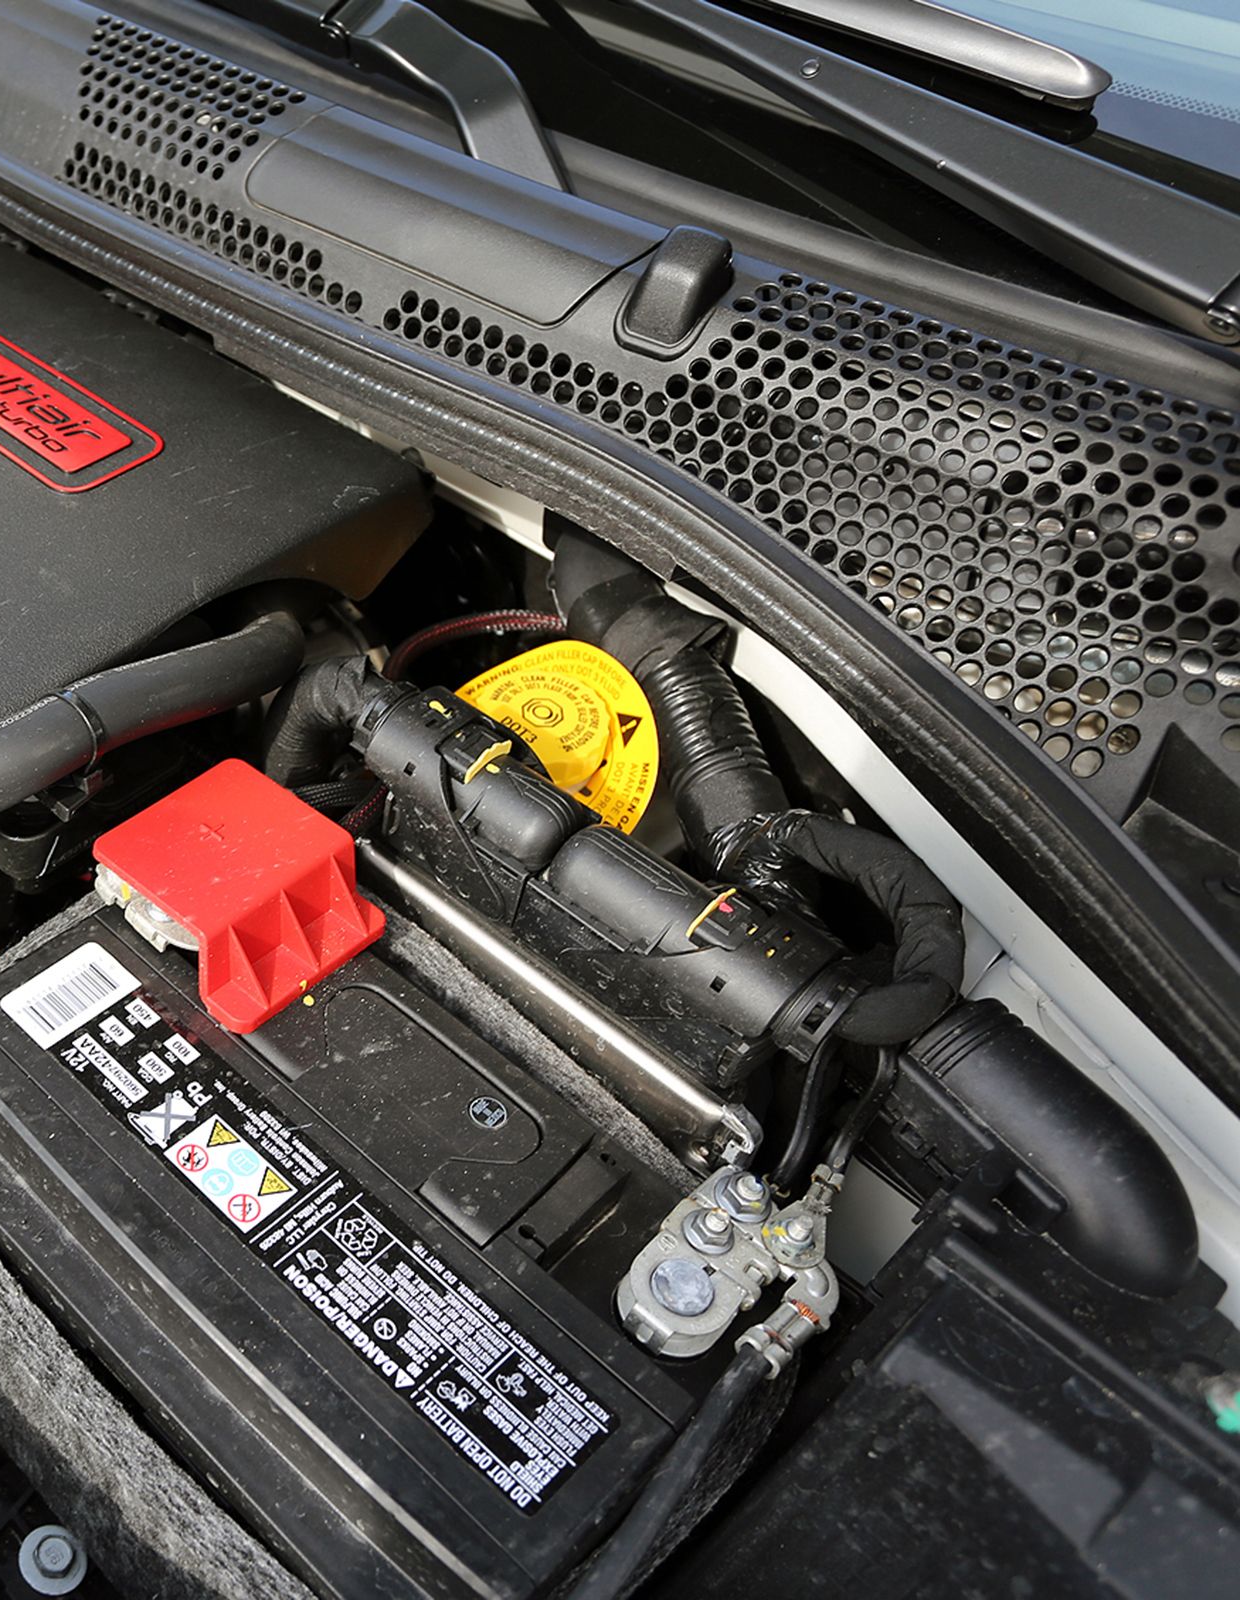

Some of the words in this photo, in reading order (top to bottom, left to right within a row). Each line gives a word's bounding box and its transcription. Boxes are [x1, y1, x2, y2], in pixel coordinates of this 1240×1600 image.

[524, 653, 554, 668] CLEAN
[556, 649, 580, 660] FILLER
[583, 652, 598, 663] CAP
[599, 660, 627, 689] BEFORE
[551, 664, 575, 673] ONLY
[576, 665, 592, 677] DOT
[600, 676, 620, 700] FLUID
[551, 677, 579, 692] FILLER
[580, 694, 595, 705] CAP
[500, 716, 537, 743] DOT3
[612, 761, 625, 783] DOT
[622, 762, 638, 798] AVANT
[636, 762, 650, 794] MISE
[611, 799, 625, 815] DE
[627, 796, 641, 814] EN
[131, 1003, 153, 1021] 450
[108, 1023, 125, 1037] 60
[59, 1045, 92, 1073] 12V
[171, 1040, 191, 1057] 100
[136, 1067, 154, 1083] CCA
[145, 1057, 167, 1076] 500
[110, 1088, 133, 1108] PART
[181, 1079, 214, 1107] Pb
[242, 1106, 270, 1131] Battery
[263, 1127, 294, 1154] Controls
[278, 1127, 292, 1139] WI
[289, 1151, 320, 1179] Johnson
[290, 1165, 312, 1185] DIST.
[312, 1177, 346, 1206] Auburn
[281, 1217, 298, 1232] MI
[299, 1199, 338, 1232] Chrysler
[283, 1226, 306, 1246] LLC
[334, 1264, 349, 1277] OR
[341, 1256, 366, 1279] BURNS
[368, 1262, 398, 1289] FOLLOW
[395, 1260, 415, 1279] SEEK
[424, 1253, 446, 1273] NOT
[312, 1271, 334, 1292] ACID
[343, 1272, 379, 1305] BLINDNESS
[360, 1274, 387, 1299] SEVERE
[441, 1268, 458, 1285] DO
[335, 1279, 359, 1301] CAUSE
[454, 1280, 500, 1323] CHILDREN.
[327, 1286, 363, 1320] SULFURIC
[353, 1296, 371, 1312] CAN
[416, 1294, 444, 1319] VEHICLE
[442, 1304, 460, 1321] NOT
[280, 1263, 400, 1377] DANGER/POISON
[422, 1312, 444, 1333] JUMP
[461, 1322, 475, 1335] OR
[496, 1318, 512, 1333] OF
[403, 1329, 433, 1357] FLAMES
[407, 1318, 441, 1350] SMOKING
[439, 1328, 457, 1345] FOR
[446, 1321, 494, 1366] INSTRUCTIONS
[471, 1330, 502, 1359] MANUAL
[479, 1324, 509, 1352] SERVICE
[507, 1329, 540, 1359] REACH
[395, 1336, 425, 1364] SPARKS
[405, 1361, 423, 1378] NO
[453, 1362, 483, 1389] INJURY
[535, 1354, 556, 1374] THE
[533, 1374, 556, 1395] HELP
[552, 1369, 569, 1385] OF
[477, 1384, 493, 1399] OR
[564, 1380, 587, 1403] OUT
[415, 1393, 466, 1444] BATTERY
[488, 1394, 529, 1434] BLINDNESS
[551, 1390, 585, 1422] MEDICAL
[583, 1397, 610, 1423] KEEP
[481, 1403, 514, 1435] GASES
[532, 1414, 555, 1436] EYES
[534, 1402, 585, 1450] IMMEDIATELY
[568, 1420, 592, 1442] WITH
[581, 1417, 599, 1435] GET
[458, 1435, 494, 1470] OPEN
[508, 1429, 559, 1478] EXPLOSIVE
[524, 1428, 552, 1455] CAUSE
[549, 1430, 577, 1457] FLUSH
[547, 1449, 567, 1469] CAN
[485, 1461, 516, 1493] NOT
[507, 1458, 544, 1494] SHIELD
[523, 1458, 552, 1486] EYES
[507, 1483, 533, 1509] DO
